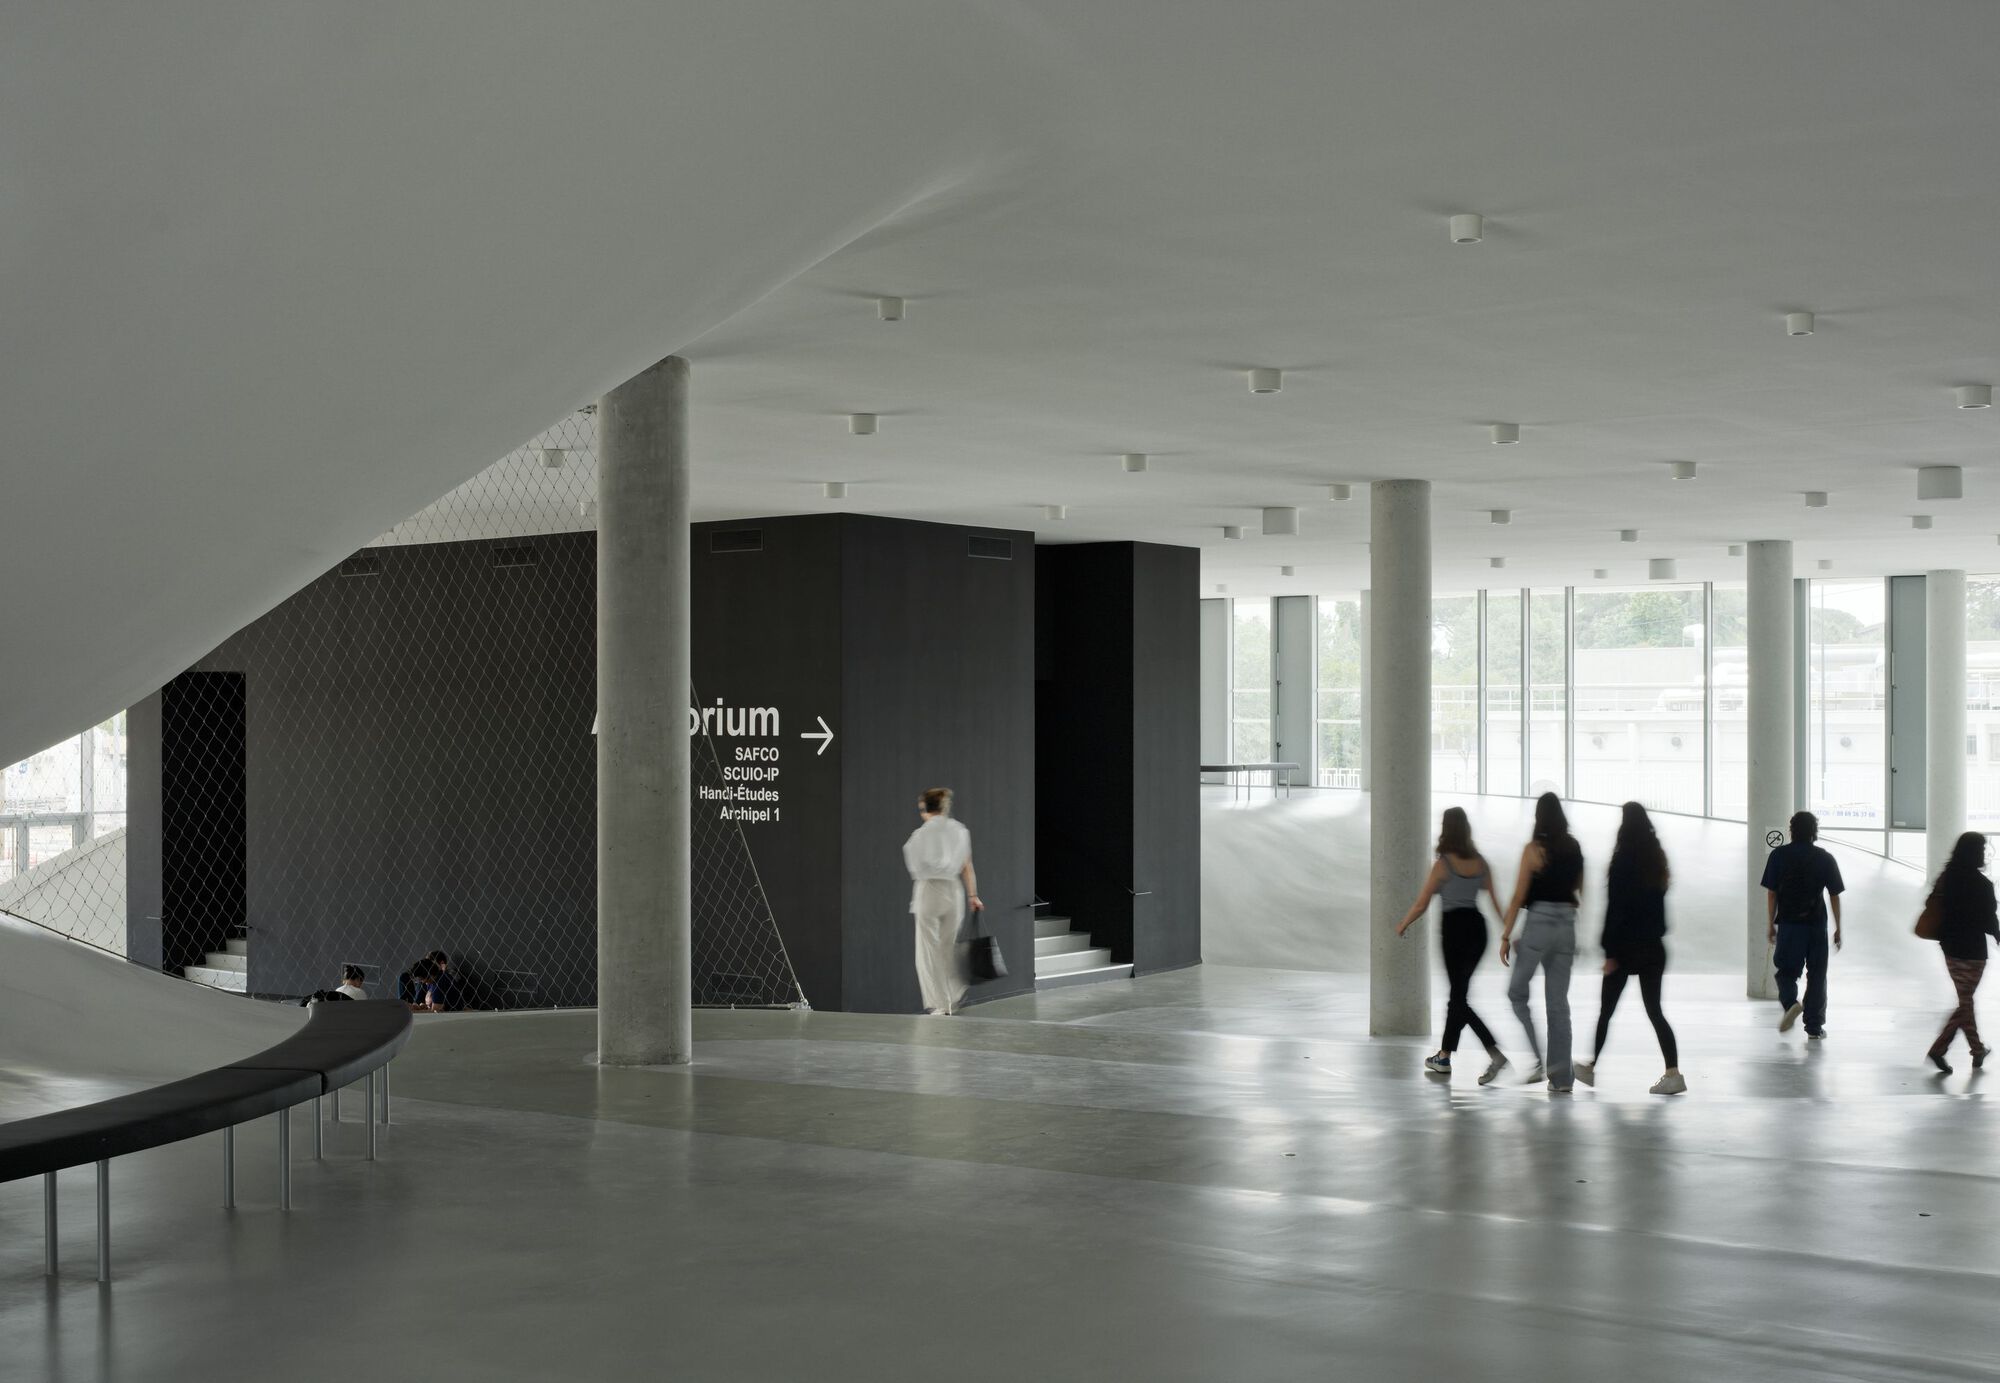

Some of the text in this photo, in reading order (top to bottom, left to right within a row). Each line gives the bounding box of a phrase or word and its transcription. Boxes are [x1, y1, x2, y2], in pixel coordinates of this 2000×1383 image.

[735, 747, 779, 761] SAFCO
[724, 766, 779, 781] SCUIO-IP
[700, 783, 779, 801] Handi-Études
[720, 806, 780, 824] Archipel 1
